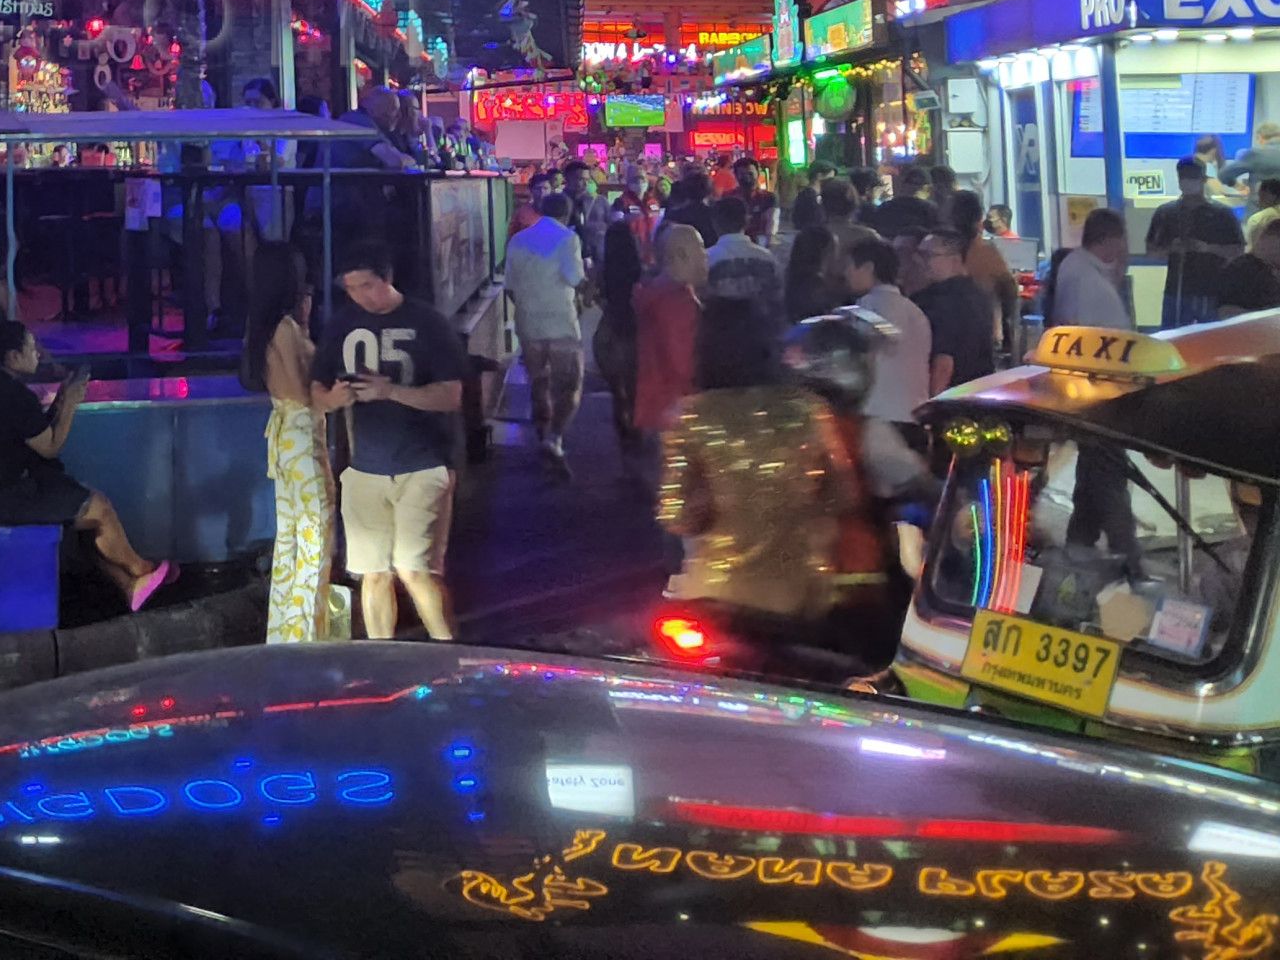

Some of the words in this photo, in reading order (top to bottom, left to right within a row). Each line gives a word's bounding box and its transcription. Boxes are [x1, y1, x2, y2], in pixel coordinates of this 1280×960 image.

[1129, 174, 1162, 191] OPEN
[342, 327, 417, 387] 05
[1051, 333, 1137, 363] TAXI
[1035, 632, 1111, 679] 3397
